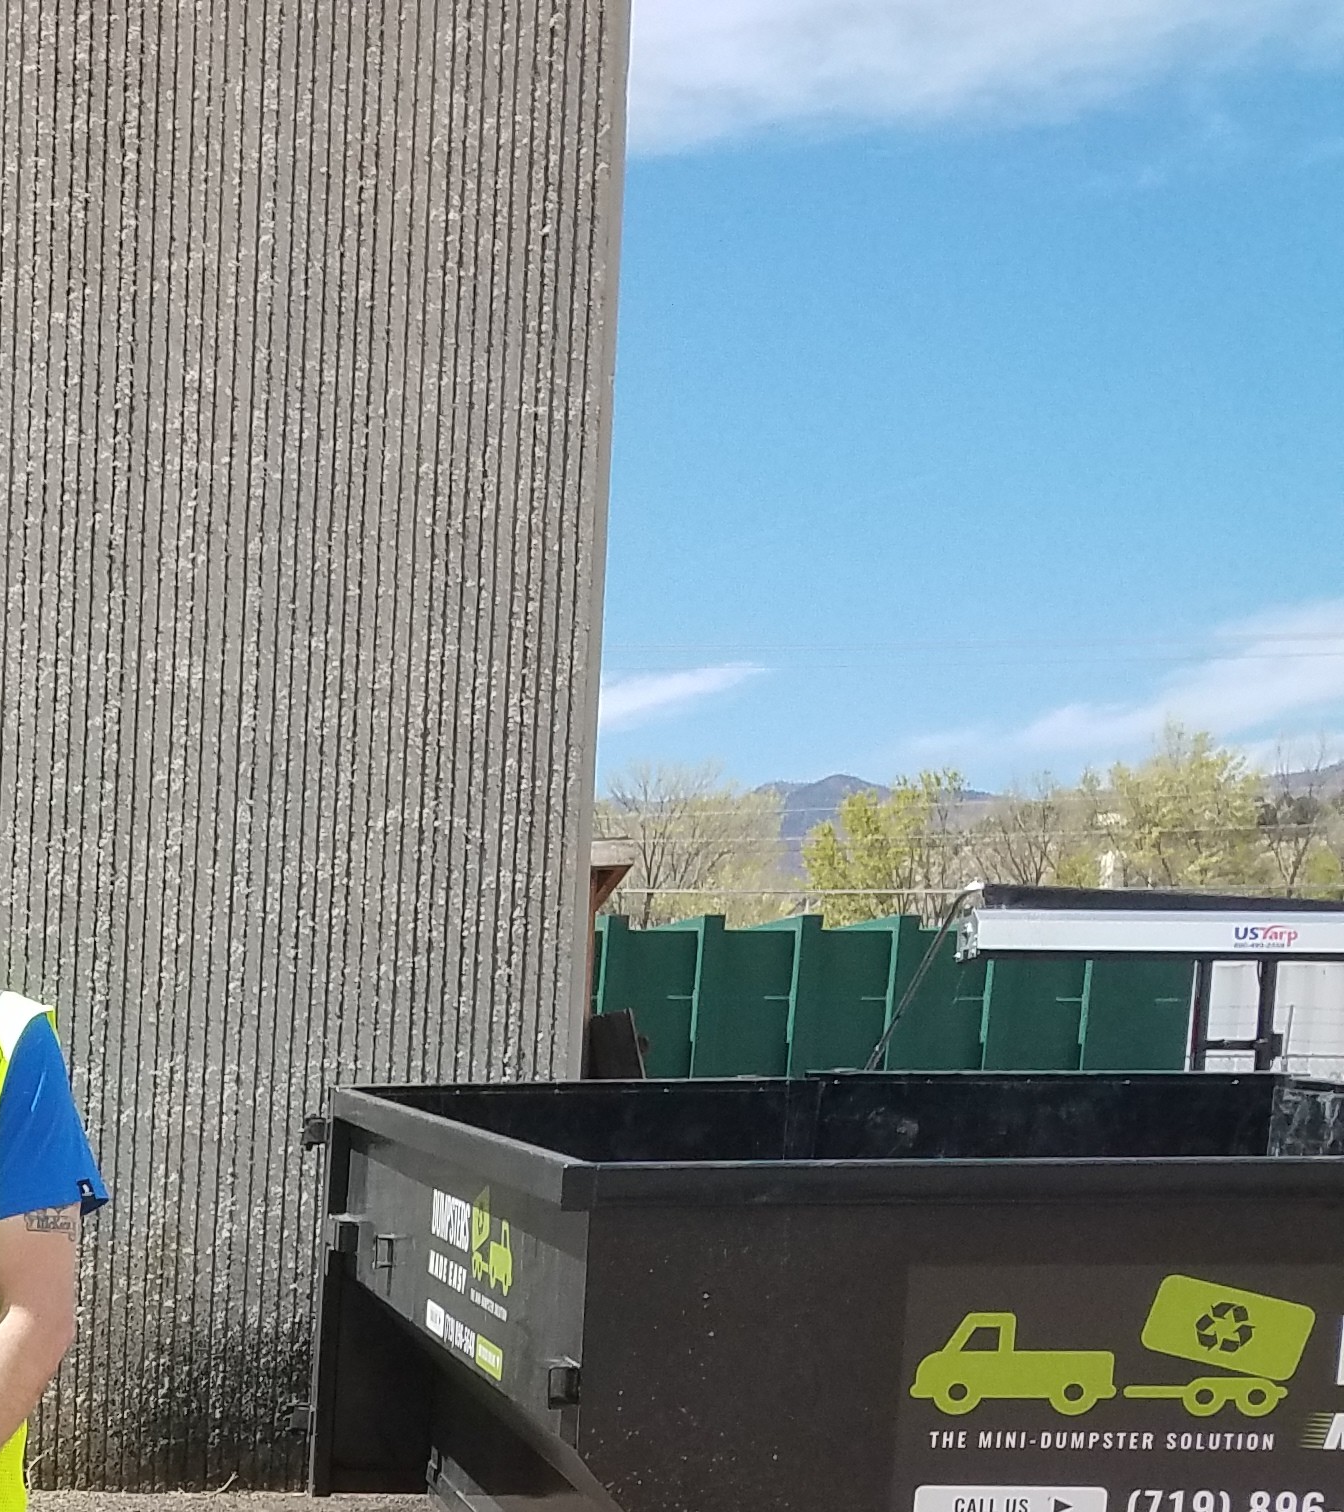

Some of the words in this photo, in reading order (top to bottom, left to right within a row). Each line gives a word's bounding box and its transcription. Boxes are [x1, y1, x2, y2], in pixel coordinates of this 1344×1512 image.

[431, 1188, 471, 1252] DUMPSTERS
[428, 1249, 448, 1283] MADE
[448, 1260, 467, 1294] EASY
[929, 1430, 967, 1449] THE
[978, 1431, 1154, 1450] MINI-DUMPSTER
[1166, 1432, 1275, 1451] SOLUTION
